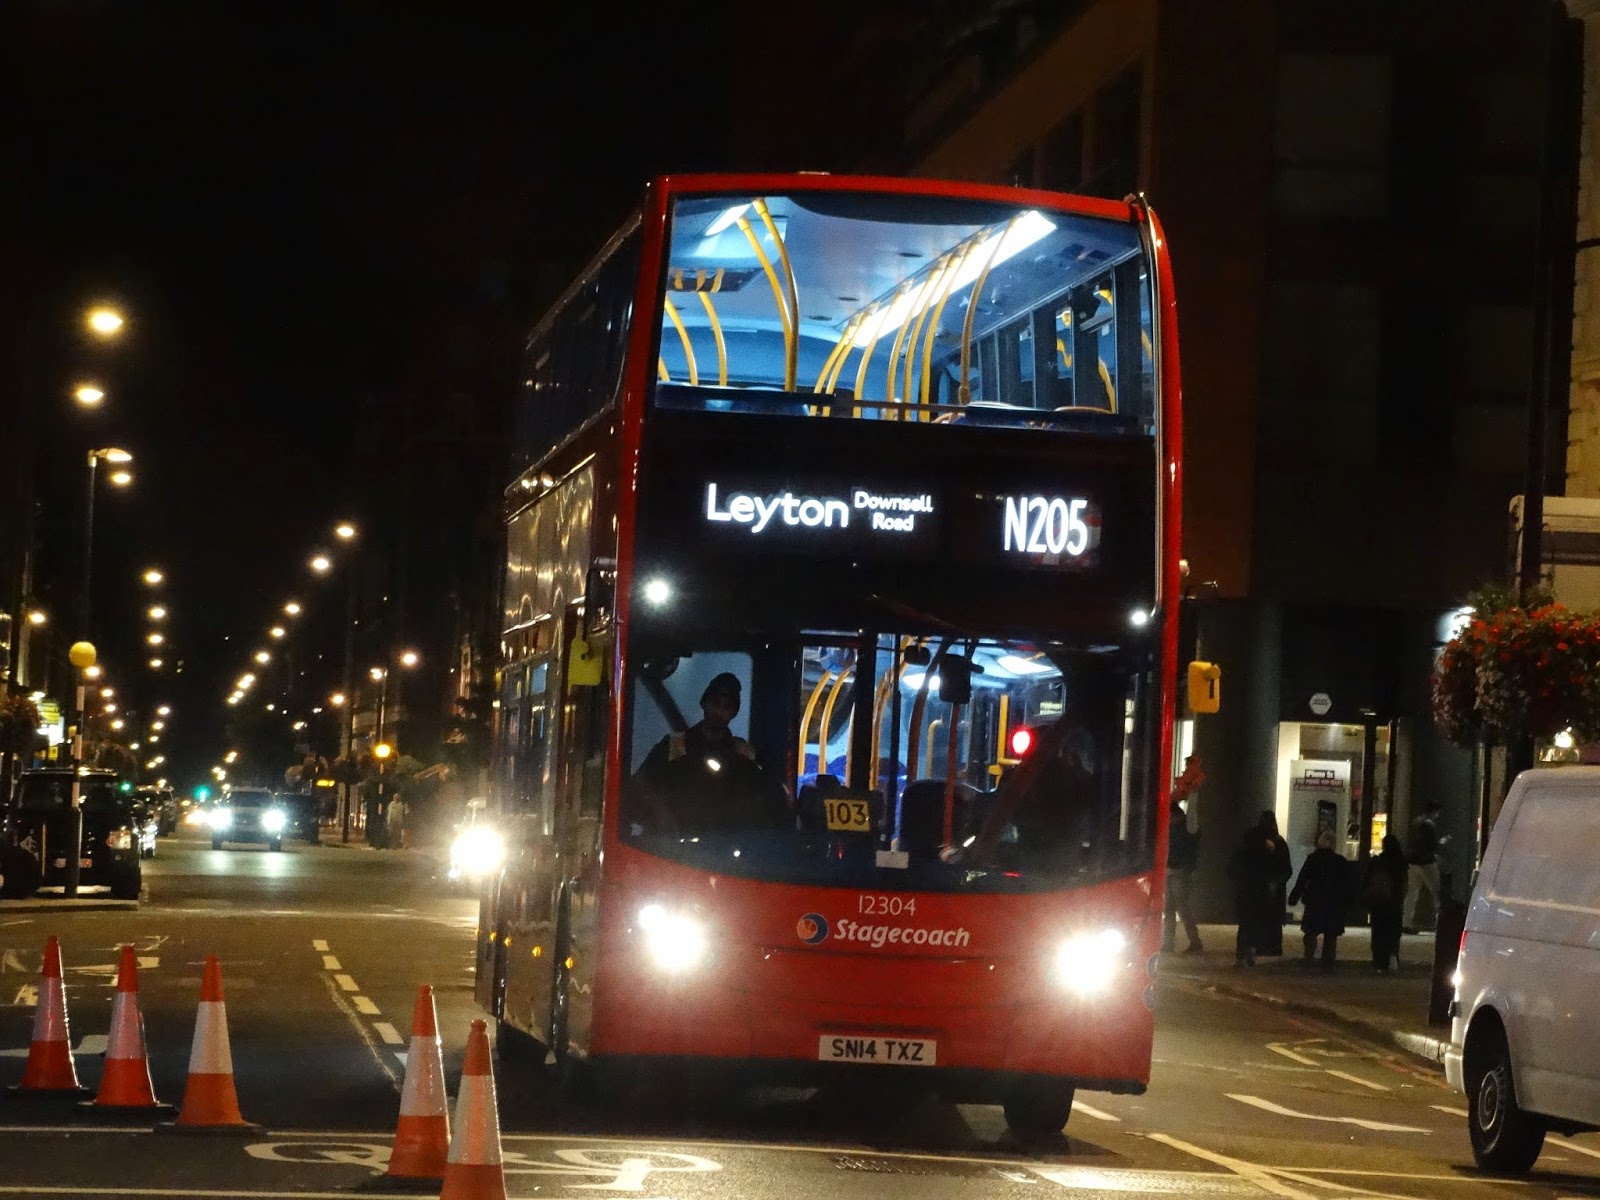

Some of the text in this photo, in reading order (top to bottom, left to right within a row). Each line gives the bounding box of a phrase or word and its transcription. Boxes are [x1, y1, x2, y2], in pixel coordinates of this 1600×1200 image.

[706, 482, 849, 534] Leyton
[854, 490, 934, 513] Downsell
[872, 512, 915, 532] Road
[1004, 496, 1088, 556] N205
[828, 802, 868, 826] 103
[858, 895, 916, 917] 12304
[834, 918, 970, 949] Stagecoach
[831, 1038, 925, 1062] SN14 TXZ
